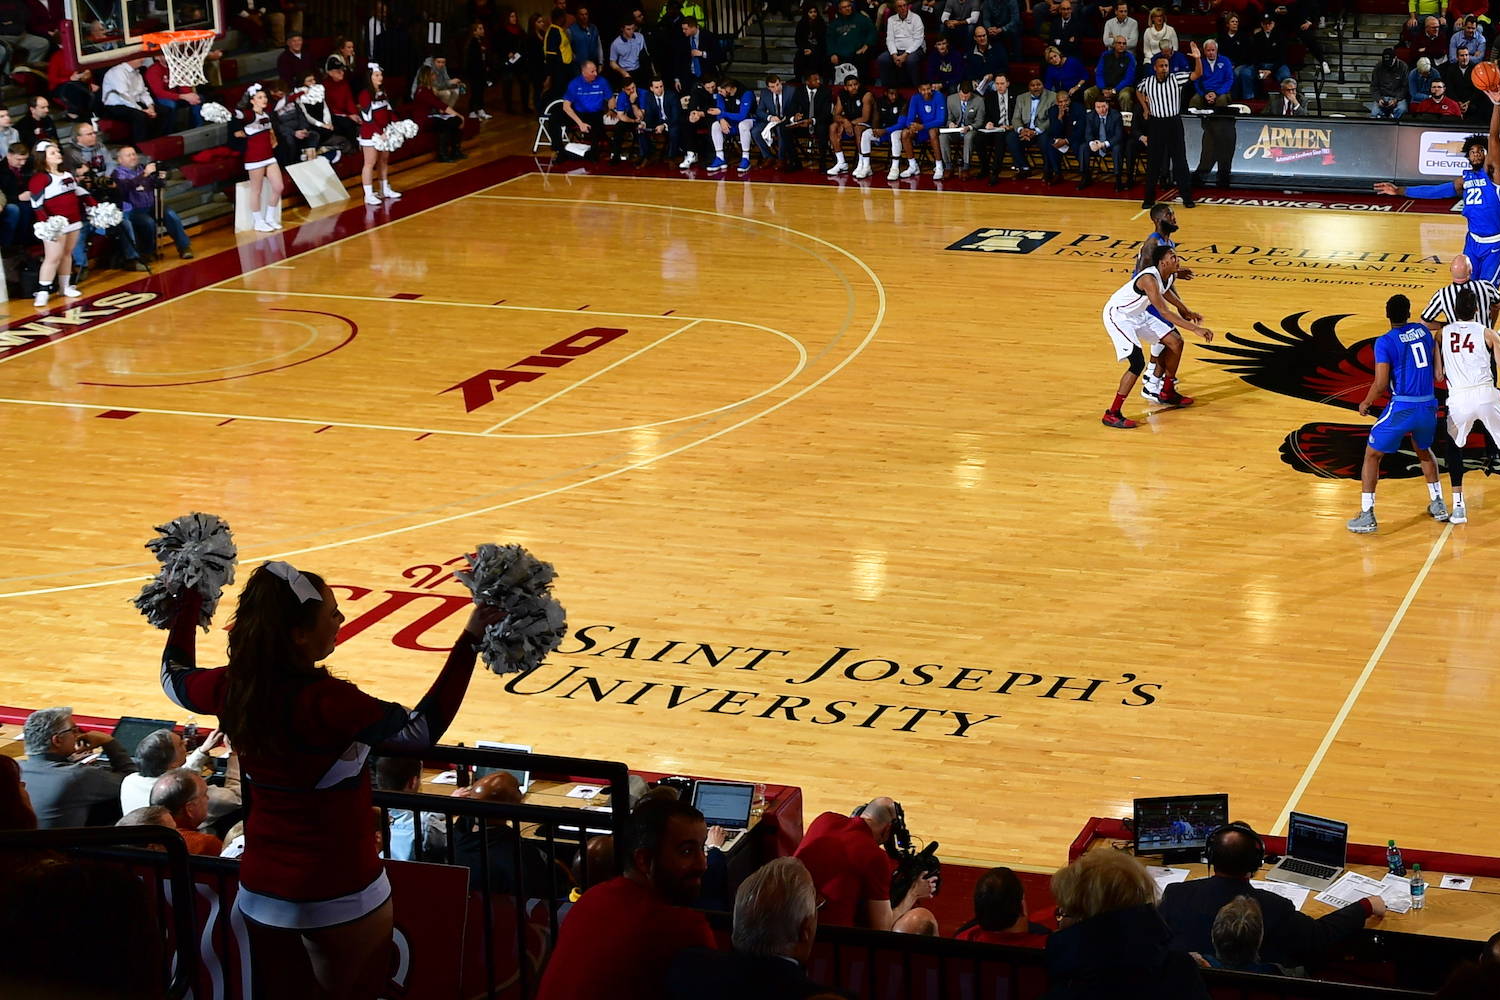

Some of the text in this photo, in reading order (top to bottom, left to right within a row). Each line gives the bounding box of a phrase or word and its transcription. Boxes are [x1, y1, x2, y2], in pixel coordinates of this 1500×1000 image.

[1242, 124, 1333, 160] ARMEN
[1426, 159, 1468, 169] CHEVRO
[1465, 188, 1483, 205] 22
[1065, 233, 1444, 265] PHLADELPHIA
[1248, 257, 1439, 275] COMPANIES
[1212, 273, 1244, 281] the
[1302, 278, 1363, 286] Marine
[1369, 281, 1424, 290] Group
[1410, 342, 1429, 369] 0
[1450, 332, 1475, 354] 24
[437, 326, 629, 414] A10
[553, 623, 1163, 707] SAINT JOSEPH'S
[504, 663, 1002, 738] UNIVERSITY
